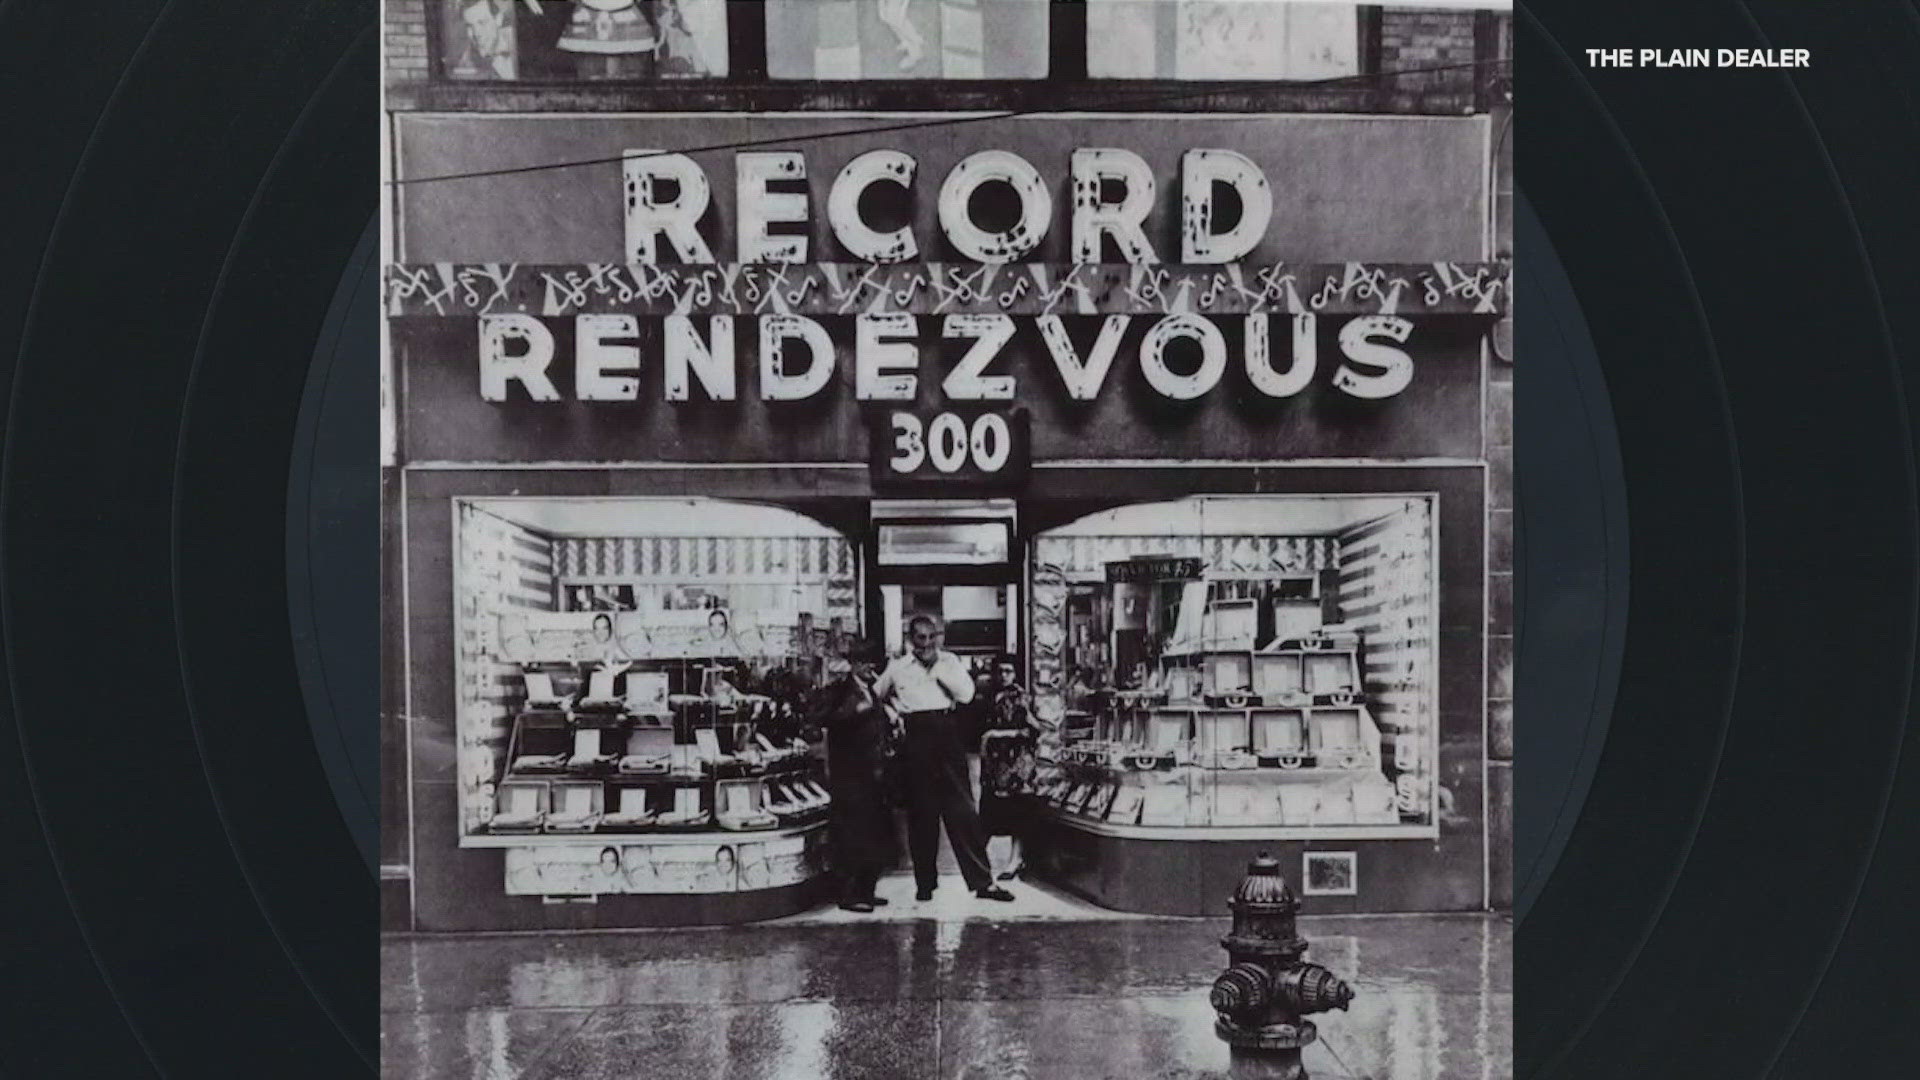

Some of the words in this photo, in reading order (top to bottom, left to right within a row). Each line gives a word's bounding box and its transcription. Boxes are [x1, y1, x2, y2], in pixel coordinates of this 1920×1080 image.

[622, 147, 1274, 265] RECORD
[477, 311, 1416, 402] RENDEZVOUS
[889, 411, 1012, 474] 300
